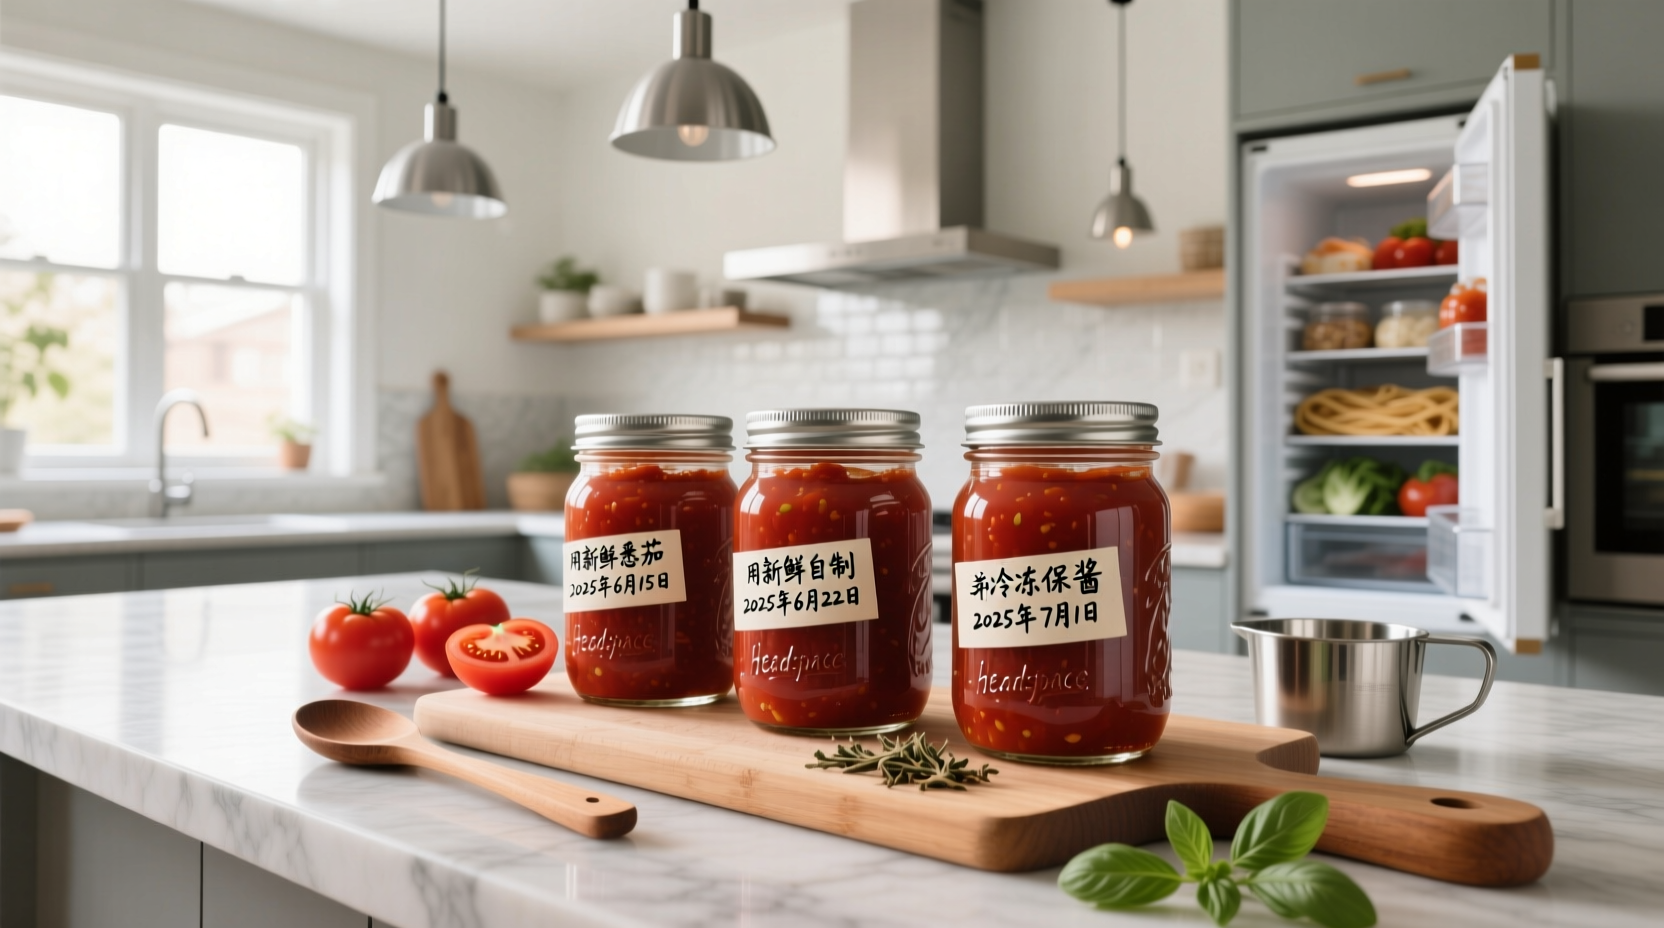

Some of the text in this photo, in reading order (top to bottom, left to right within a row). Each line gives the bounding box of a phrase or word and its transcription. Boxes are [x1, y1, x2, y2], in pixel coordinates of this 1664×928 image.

[747, 551, 855, 586] 用新鲜自制
[569, 572, 669, 598] 2025年6月15日
[743, 586, 859, 616] 2025年6月22日
[973, 601, 1098, 634] 2025年7月1日
